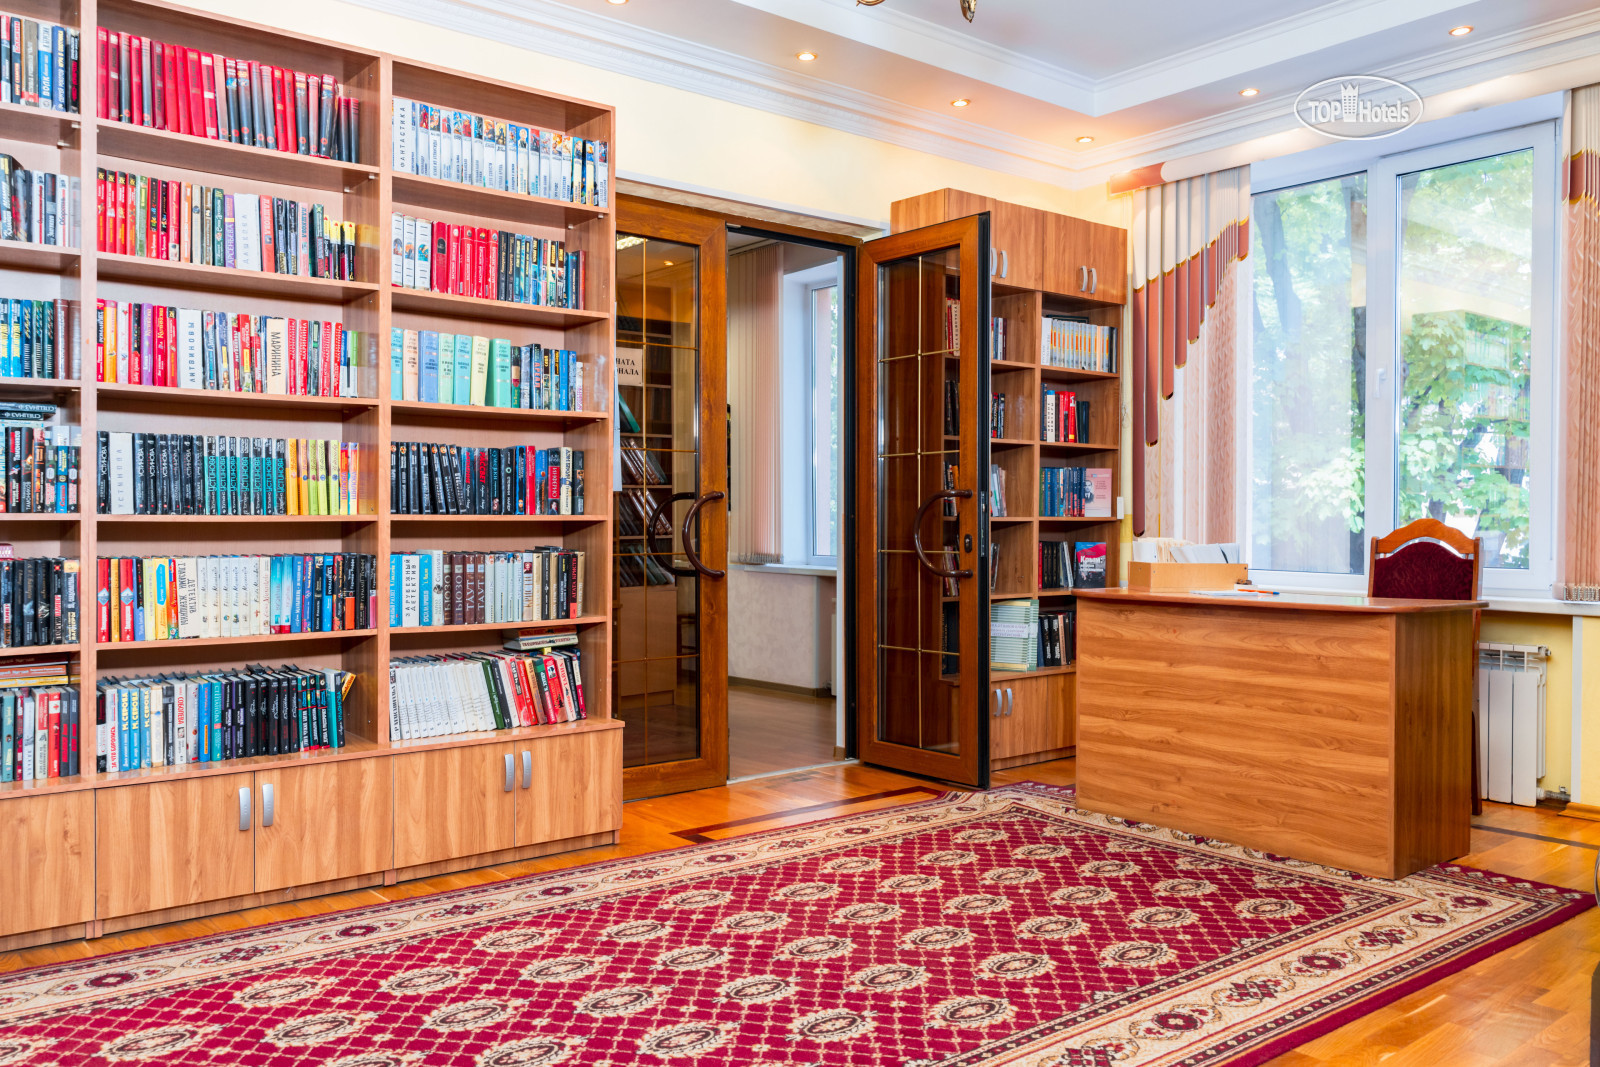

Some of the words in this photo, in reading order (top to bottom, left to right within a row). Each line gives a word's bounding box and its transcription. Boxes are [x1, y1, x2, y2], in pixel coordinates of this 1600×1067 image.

[226, 223, 235, 265] АРСЕНЬЕВА
[241, 214, 249, 265] ДАШКОВА
[188, 322, 196, 383] ЛИТВИНОВЫ
[271, 331, 281, 377] МАРИНИНА
[178, 562, 187, 590] ГЛАЗАМИ
[178, 594, 188, 626] ЖЕНЩИНЫ
[187, 578, 197, 614] ДЕТЕКТИВ
[559, 662, 568, 687] ТАЙНА
[177, 696, 185, 725] СОБОЛЕВА
